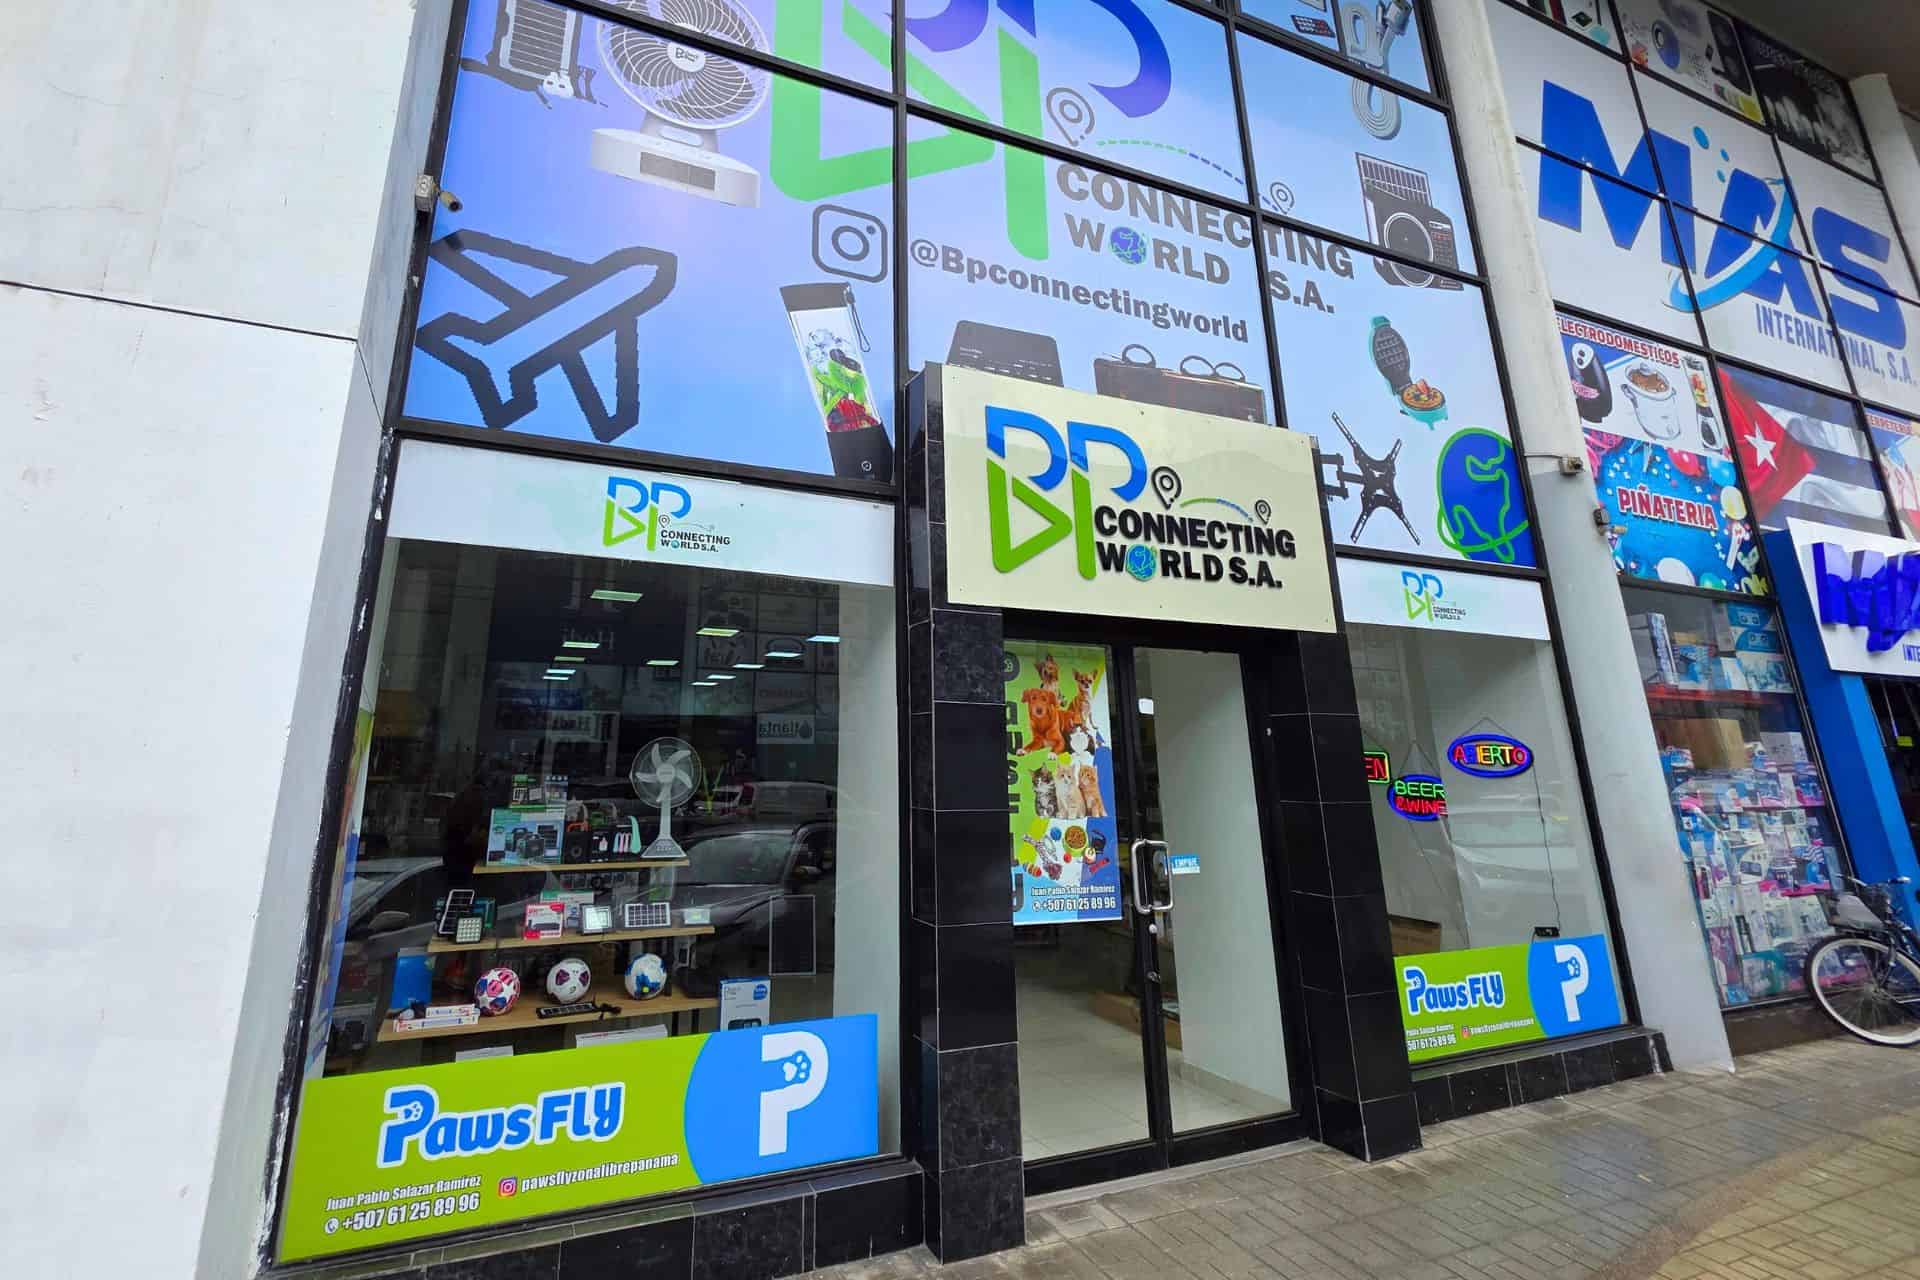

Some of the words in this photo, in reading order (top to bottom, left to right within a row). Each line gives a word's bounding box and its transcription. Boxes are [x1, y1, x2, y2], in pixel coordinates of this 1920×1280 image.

[1056, 163, 1355, 280] CONNECTING
[1538, 80, 1907, 350] MAS
[910, 239, 1249, 344] @Bpconnectingworld
[1268, 271, 1336, 313] S.A.
[1755, 303, 1885, 376] INTERNATONAL,
[1617, 484, 1719, 531] PIÑATERIA
[660, 529, 731, 546] CONNECTING
[1094, 504, 1297, 559] CONNECTING
[1229, 558, 1283, 589] S.A.
[1454, 744, 1528, 766] ABIERTO
[1394, 780, 1446, 799] BEER
[1042, 898, 1065, 912] +507
[1066, 898, 1077, 911] 61
[1078, 898, 1090, 910] 25
[1091, 897, 1103, 909] 89
[1104, 896, 1116, 909] 96
[521, 1153, 680, 1193] pawsflyzonalibrepanama
[326, 1197, 356, 1212] Juan
[357, 1189, 390, 1206] Pablo
[392, 1181, 435, 1200] Salazar
[342, 1207, 386, 1232] +507
[387, 1204, 407, 1225] 61
[409, 1200, 431, 1221] 25
[433, 1196, 455, 1217] 89
[457, 1192, 481, 1212] 96
